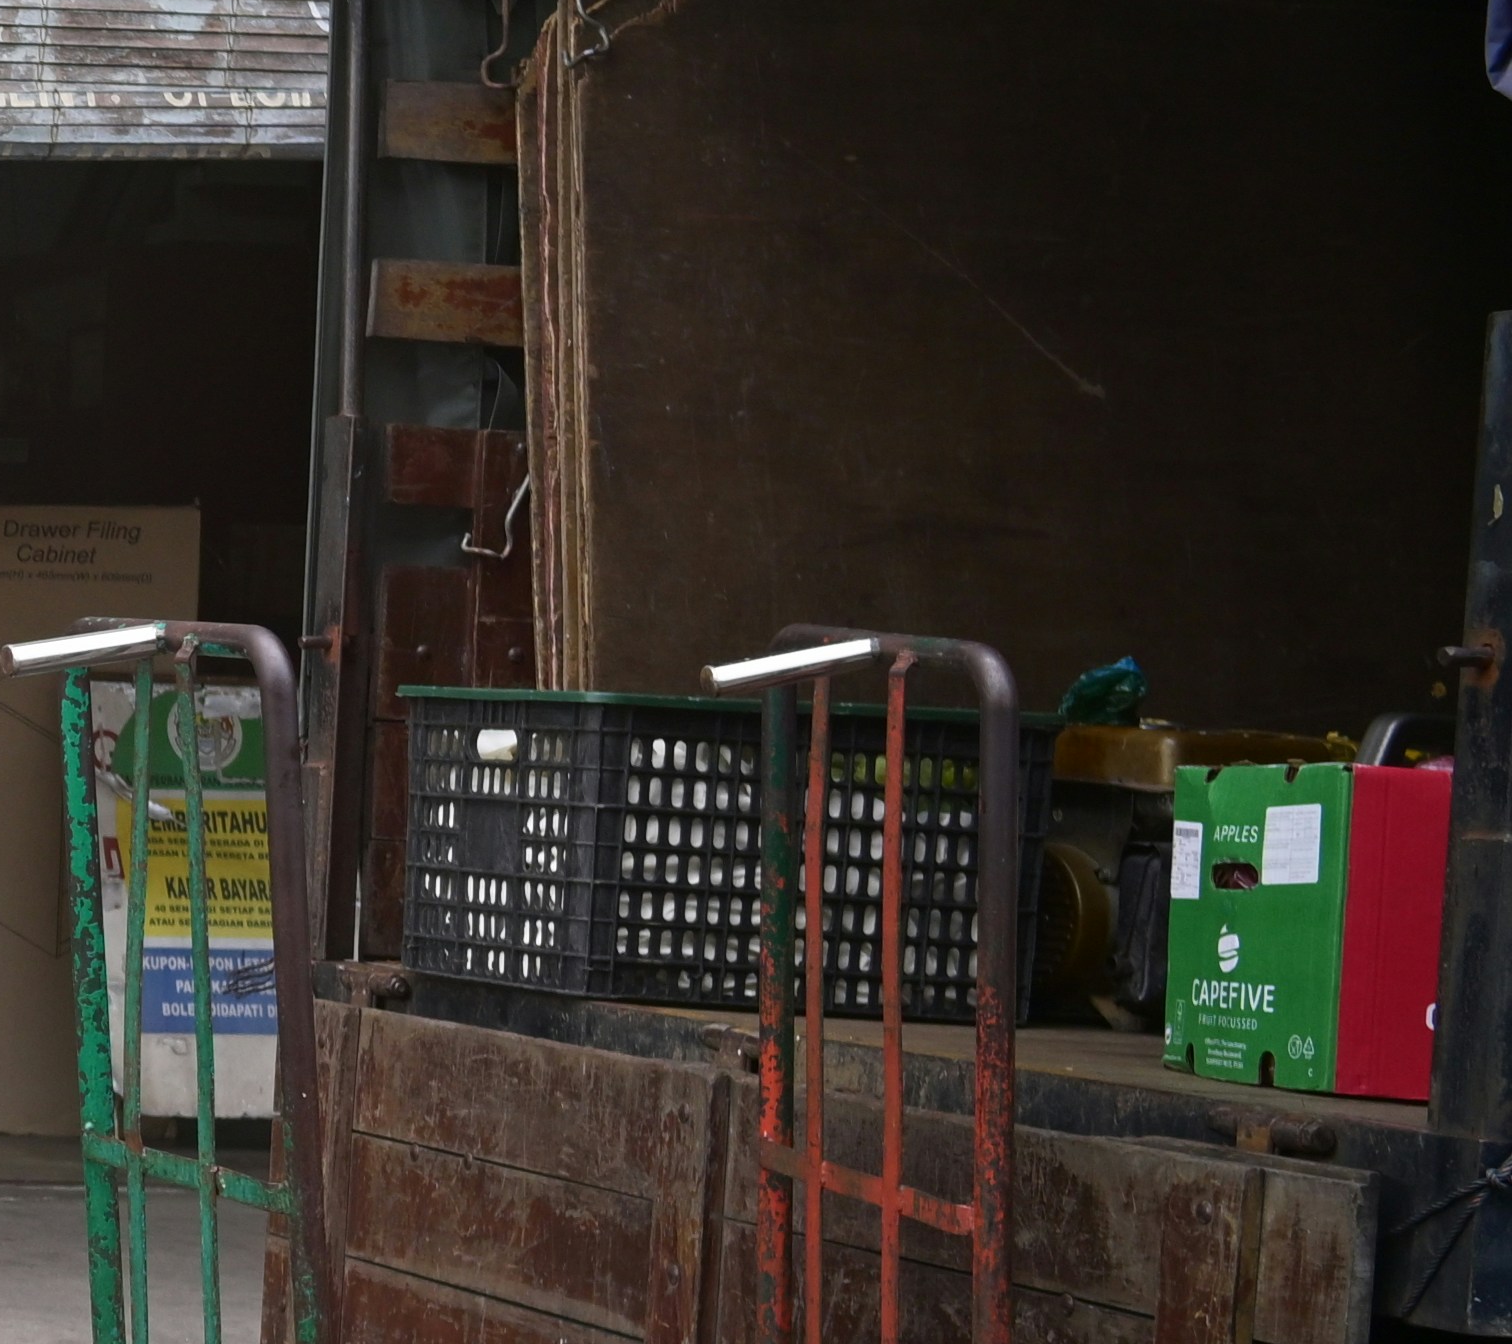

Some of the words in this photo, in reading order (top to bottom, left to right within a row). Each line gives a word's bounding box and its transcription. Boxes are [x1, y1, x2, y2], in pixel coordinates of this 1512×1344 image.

[3, 519, 82, 538] Drawer
[86, 520, 142, 545] Filing
[16, 543, 97, 565] Cabinet
[1213, 824, 1259, 844] APPLES
[165, 875, 217, 900] KAR
[1191, 978, 1275, 1014] CAPEFIVE
[162, 1001, 195, 1017] BOLE
